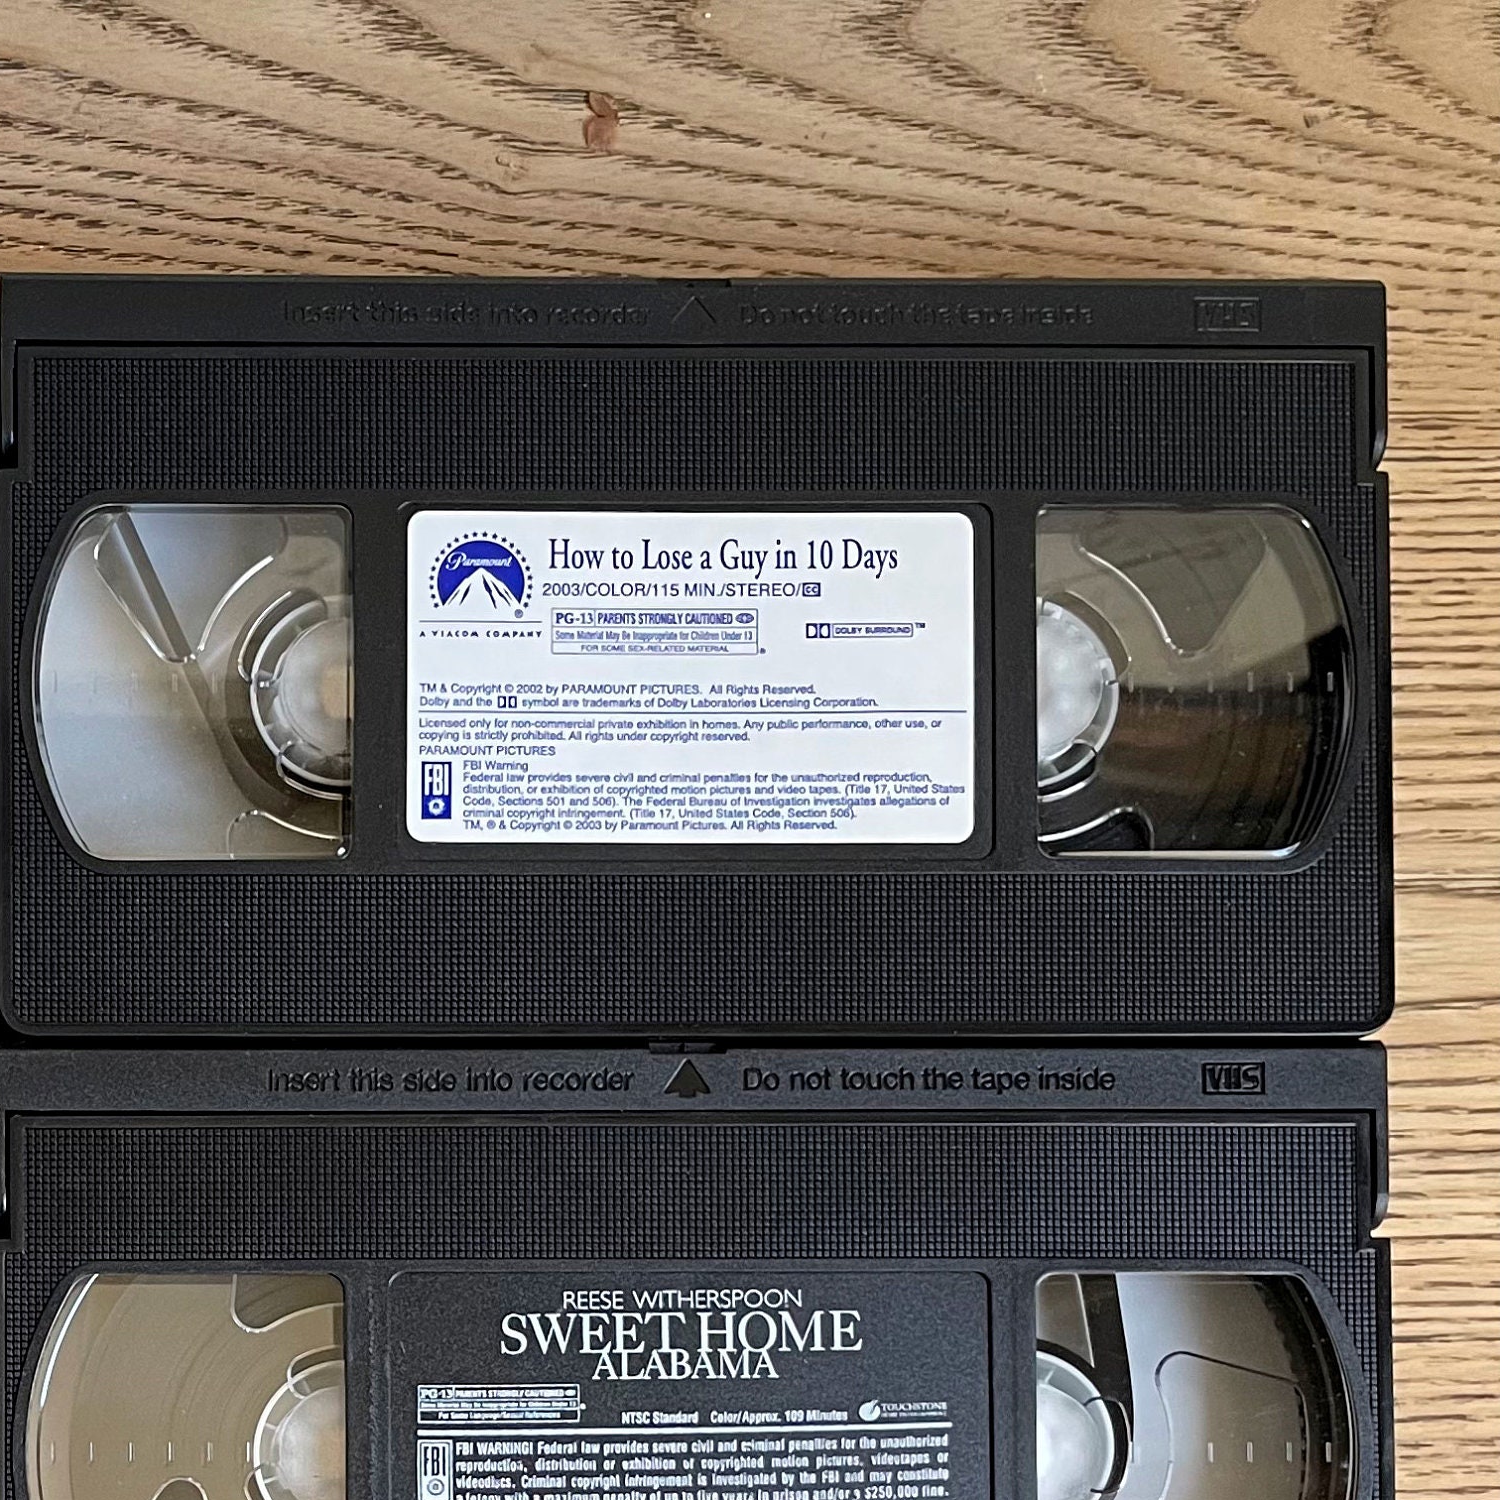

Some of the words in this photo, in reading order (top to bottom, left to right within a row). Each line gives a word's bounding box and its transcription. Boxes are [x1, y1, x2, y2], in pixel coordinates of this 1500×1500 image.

[444, 551, 514, 571] Paramount
[548, 538, 604, 569] How
[611, 547, 633, 569] to
[641, 538, 692, 570] Lose
[699, 550, 712, 569] a
[719, 538, 768, 579] Guy
[774, 539, 797, 569] in
[807, 539, 833, 569] 10
[842, 538, 897, 579] Days
[555, 612, 593, 624] PG-13
[597, 612, 636, 627] PARENTS
[638, 612, 683, 625] STRONGLY
[684, 612, 733, 624] CAUTIONED
[485, 630, 542, 638] COMPANY
[419, 683, 437, 694] TM
[439, 683, 447, 693] &
[450, 683, 501, 696] Copyright
[516, 683, 543, 694] 2002
[545, 683, 560, 696] by
[561, 684, 637, 695] PARAMOUNT
[639, 684, 702, 695] PICTURES.
[708, 684, 723, 695] All
[725, 684, 759, 697] Rights
[762, 684, 816, 695] Reserved.
[419, 744, 494, 756] PARAMOUNT
[496, 745, 556, 756] PICTURES
[462, 760, 482, 771] FBI
[484, 760, 529, 773] Warning
[424, 764, 448, 795] FBI
[268, 1067, 341, 1092] Insert
[347, 1067, 394, 1092] this
[402, 1067, 457, 1092] side
[466, 1067, 513, 1092] into
[522, 1067, 635, 1092] recorder
[742, 1067, 780, 1092] Do
[789, 1067, 831, 1091] not
[840, 1066, 915, 1091] touch
[921, 1066, 963, 1091] the
[972, 1066, 1030, 1095] tape
[1038, 1065, 1116, 1091] inside
[562, 1290, 624, 1310] REESE
[632, 1288, 802, 1309] WITHERSPOON
[500, 1311, 687, 1356] SWEET
[696, 1309, 862, 1354] HOME
[591, 1349, 780, 1380] ALABAMA
[621, 1411, 650, 1424] NTSC
[652, 1410, 699, 1424] Standard
[710, 1409, 782, 1425] Color/Approx.
[784, 1409, 804, 1422] 109
[805, 1408, 848, 1422] Minutes
[423, 1446, 446, 1476] FBI
